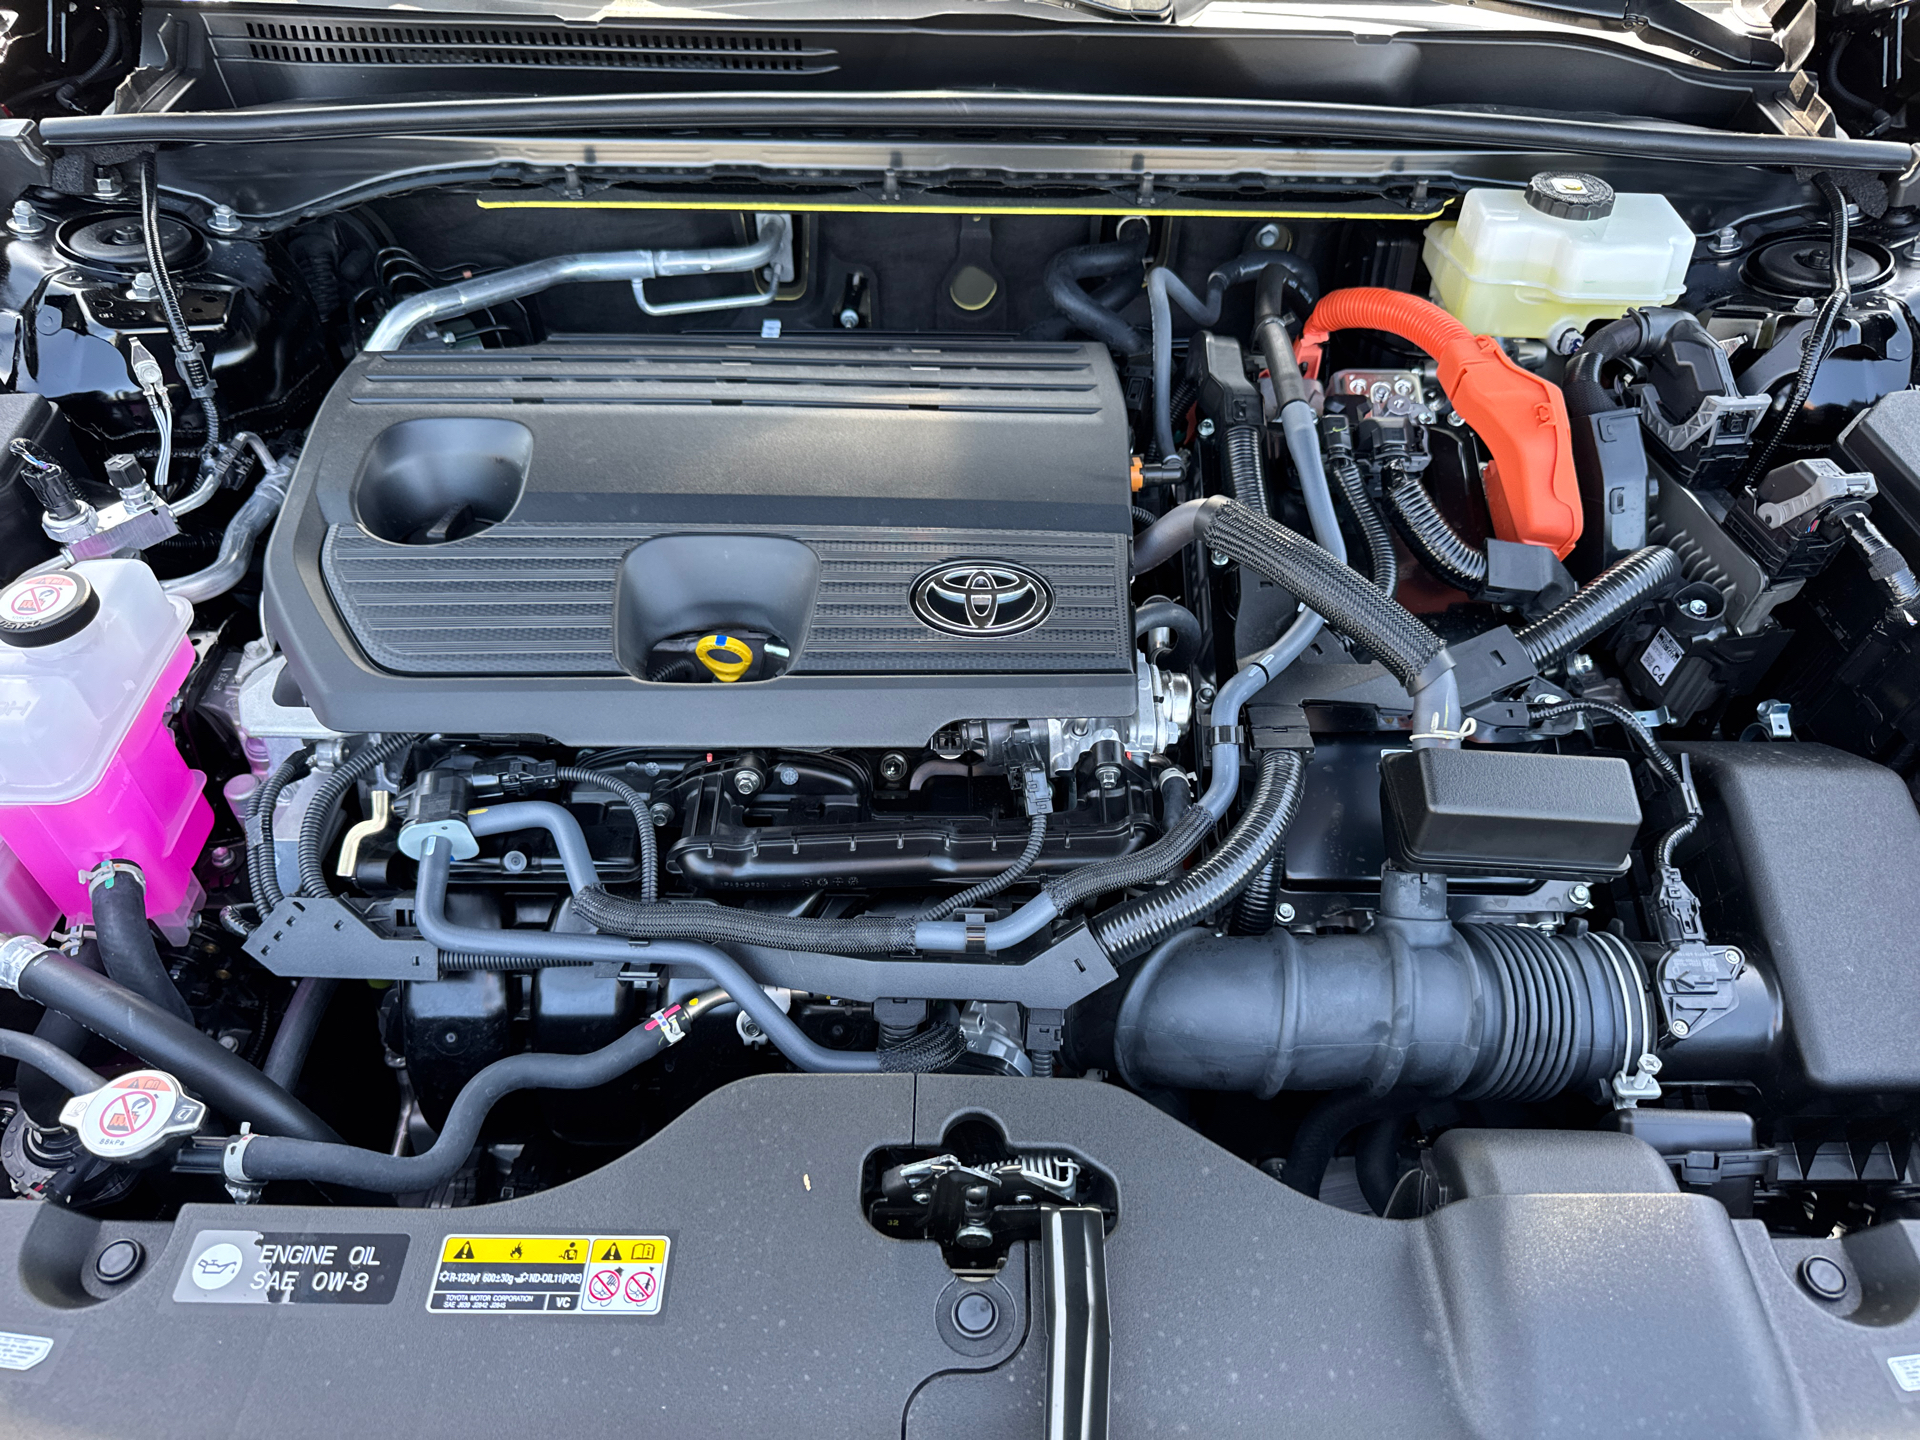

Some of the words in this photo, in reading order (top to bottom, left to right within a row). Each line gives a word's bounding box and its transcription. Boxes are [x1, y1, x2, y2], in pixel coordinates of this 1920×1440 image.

[1651, 665, 1666, 682] C4
[259, 1244, 338, 1265] ENGINE
[348, 1246, 381, 1266] OIL
[249, 1270, 300, 1291] SAE
[312, 1272, 370, 1292] 0W-8
[443, 1301, 456, 1309] SAE
[445, 1294, 469, 1302] TOYOTA
[469, 1294, 492, 1302] MOTOR
[492, 1294, 534, 1303] CORPORATION
[555, 1296, 572, 1308] VC
